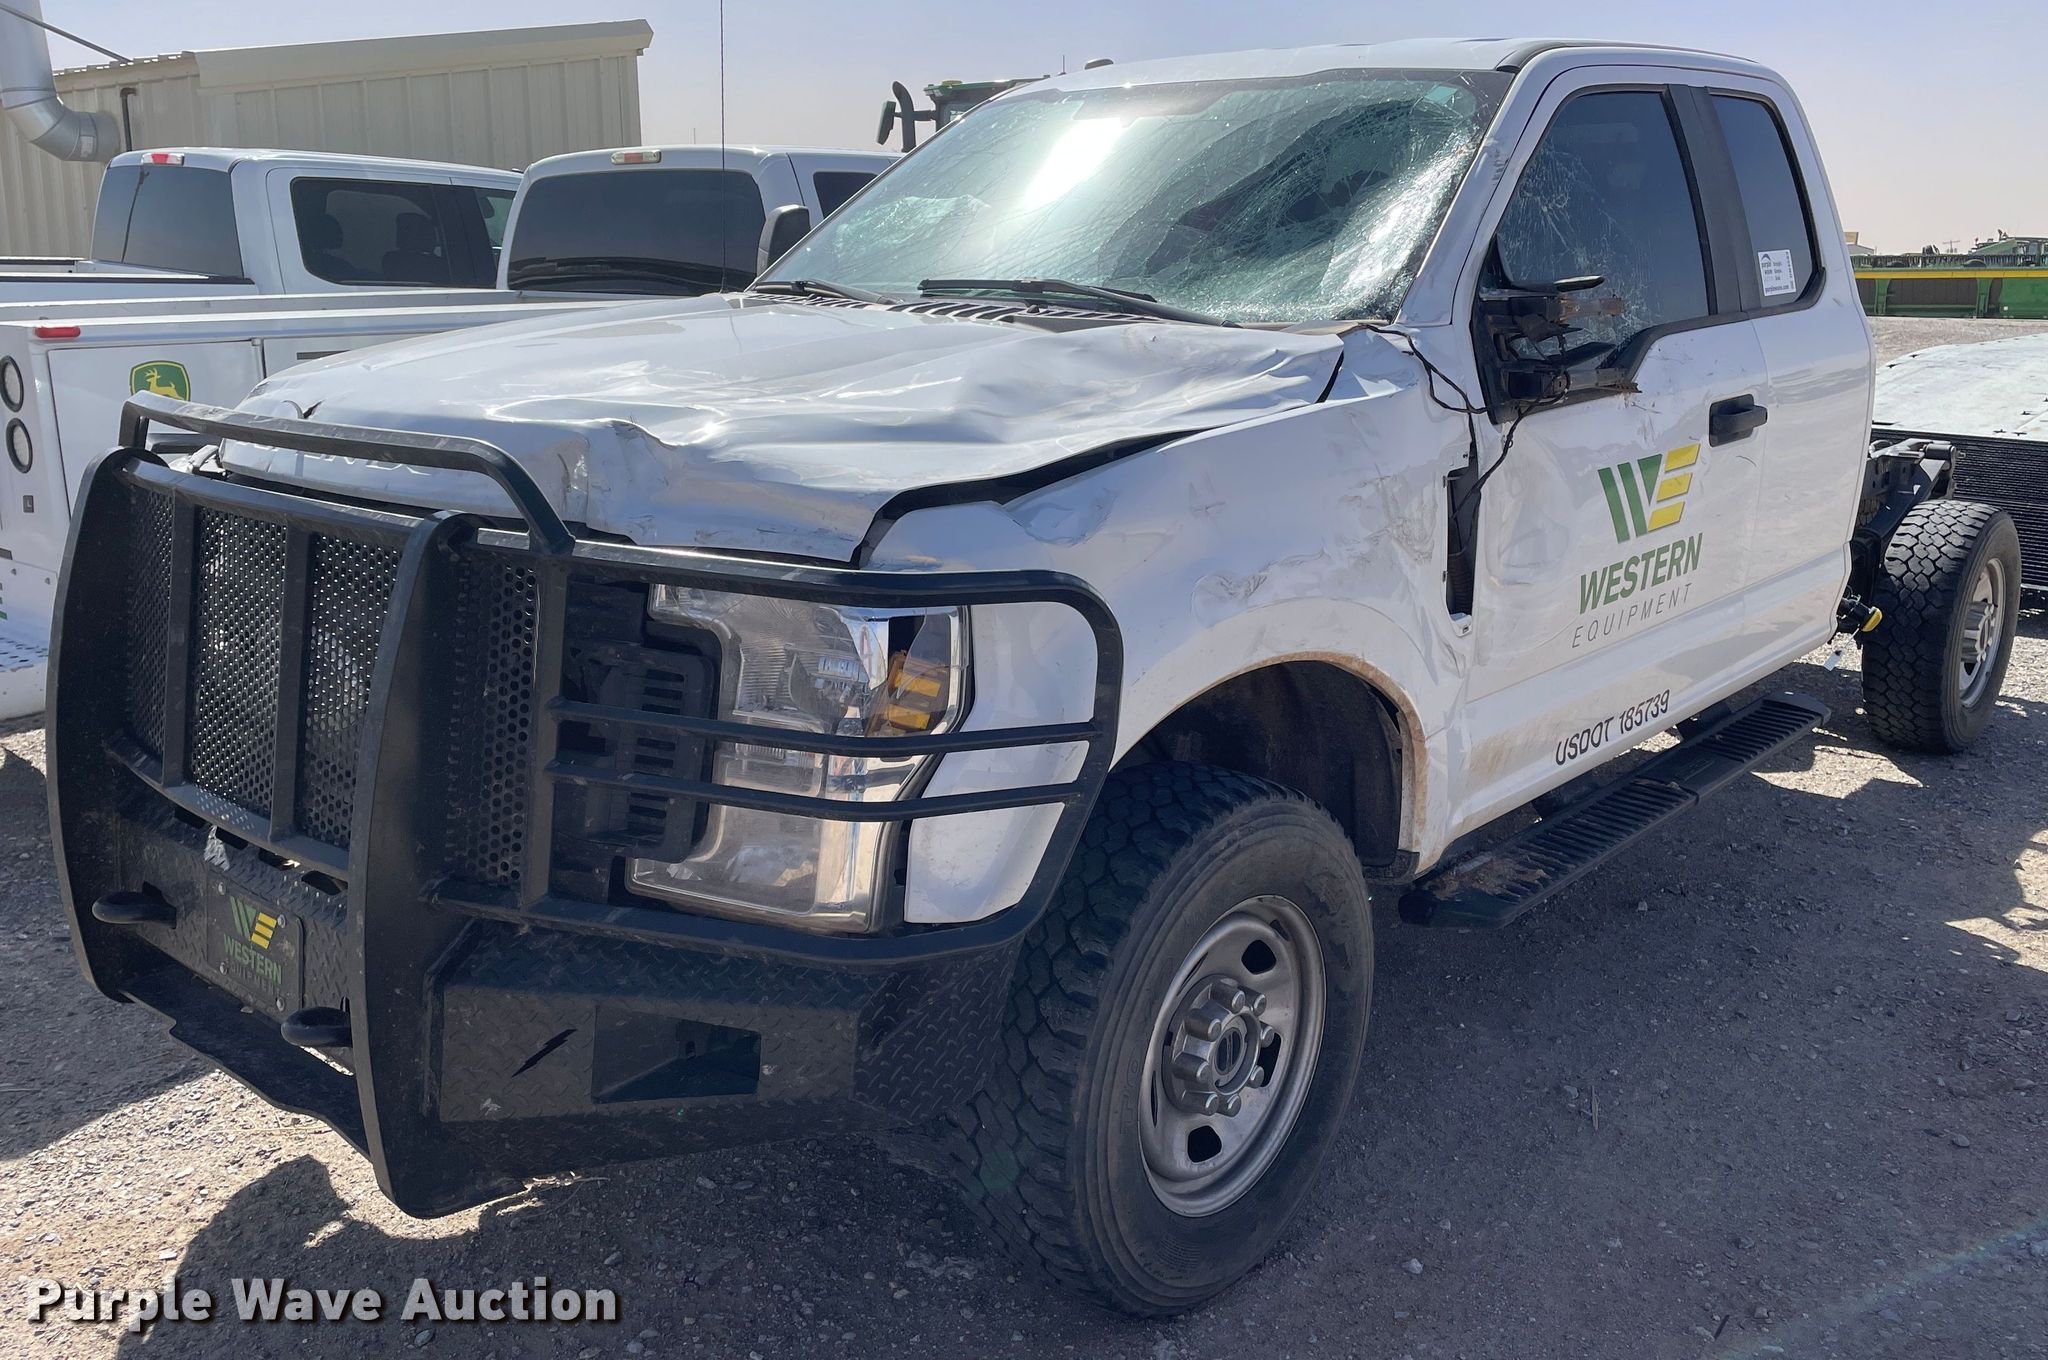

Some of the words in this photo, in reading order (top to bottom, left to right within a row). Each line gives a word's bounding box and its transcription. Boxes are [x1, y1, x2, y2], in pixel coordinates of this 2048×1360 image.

[1579, 532, 1703, 615] WESTERN
[1571, 582, 1693, 649] EQUIPMENT
[1555, 715, 1614, 766] USDOT
[1618, 688, 1671, 735] 185739
[223, 932, 282, 985] WESTERN
